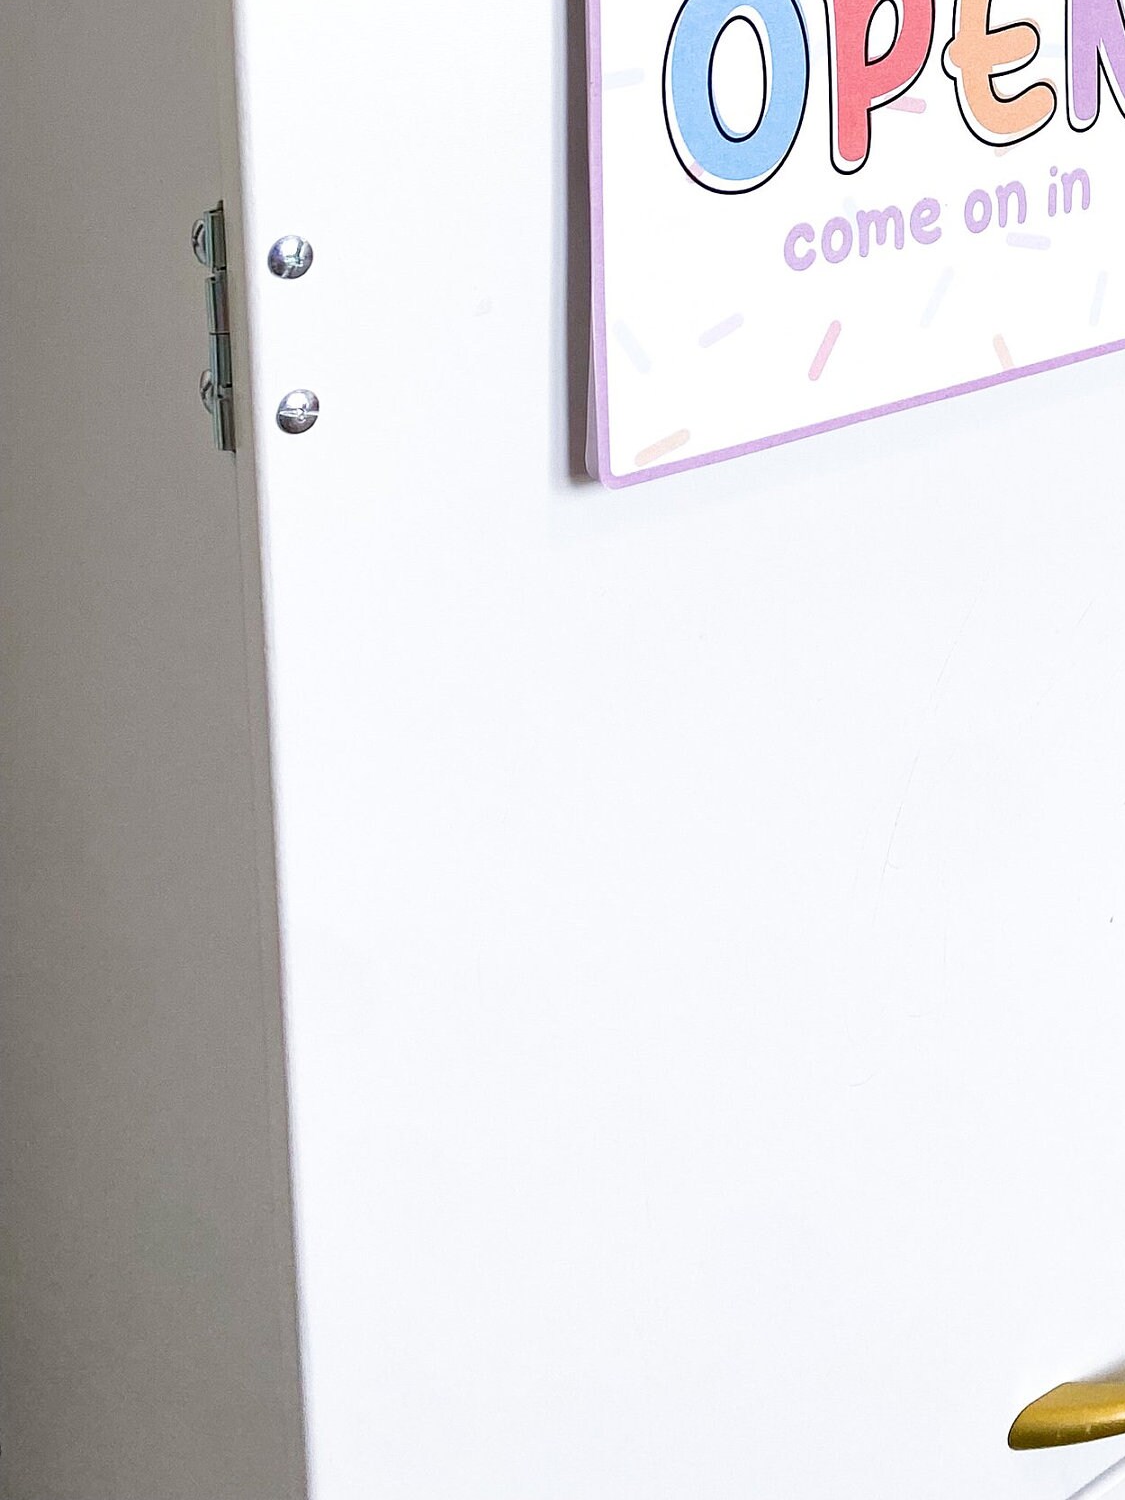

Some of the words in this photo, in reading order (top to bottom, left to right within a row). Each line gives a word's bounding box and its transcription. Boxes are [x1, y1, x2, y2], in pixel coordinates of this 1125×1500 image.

[783, 196, 943, 272] come
[963, 179, 1028, 236] on
[1046, 166, 1091, 219] in
